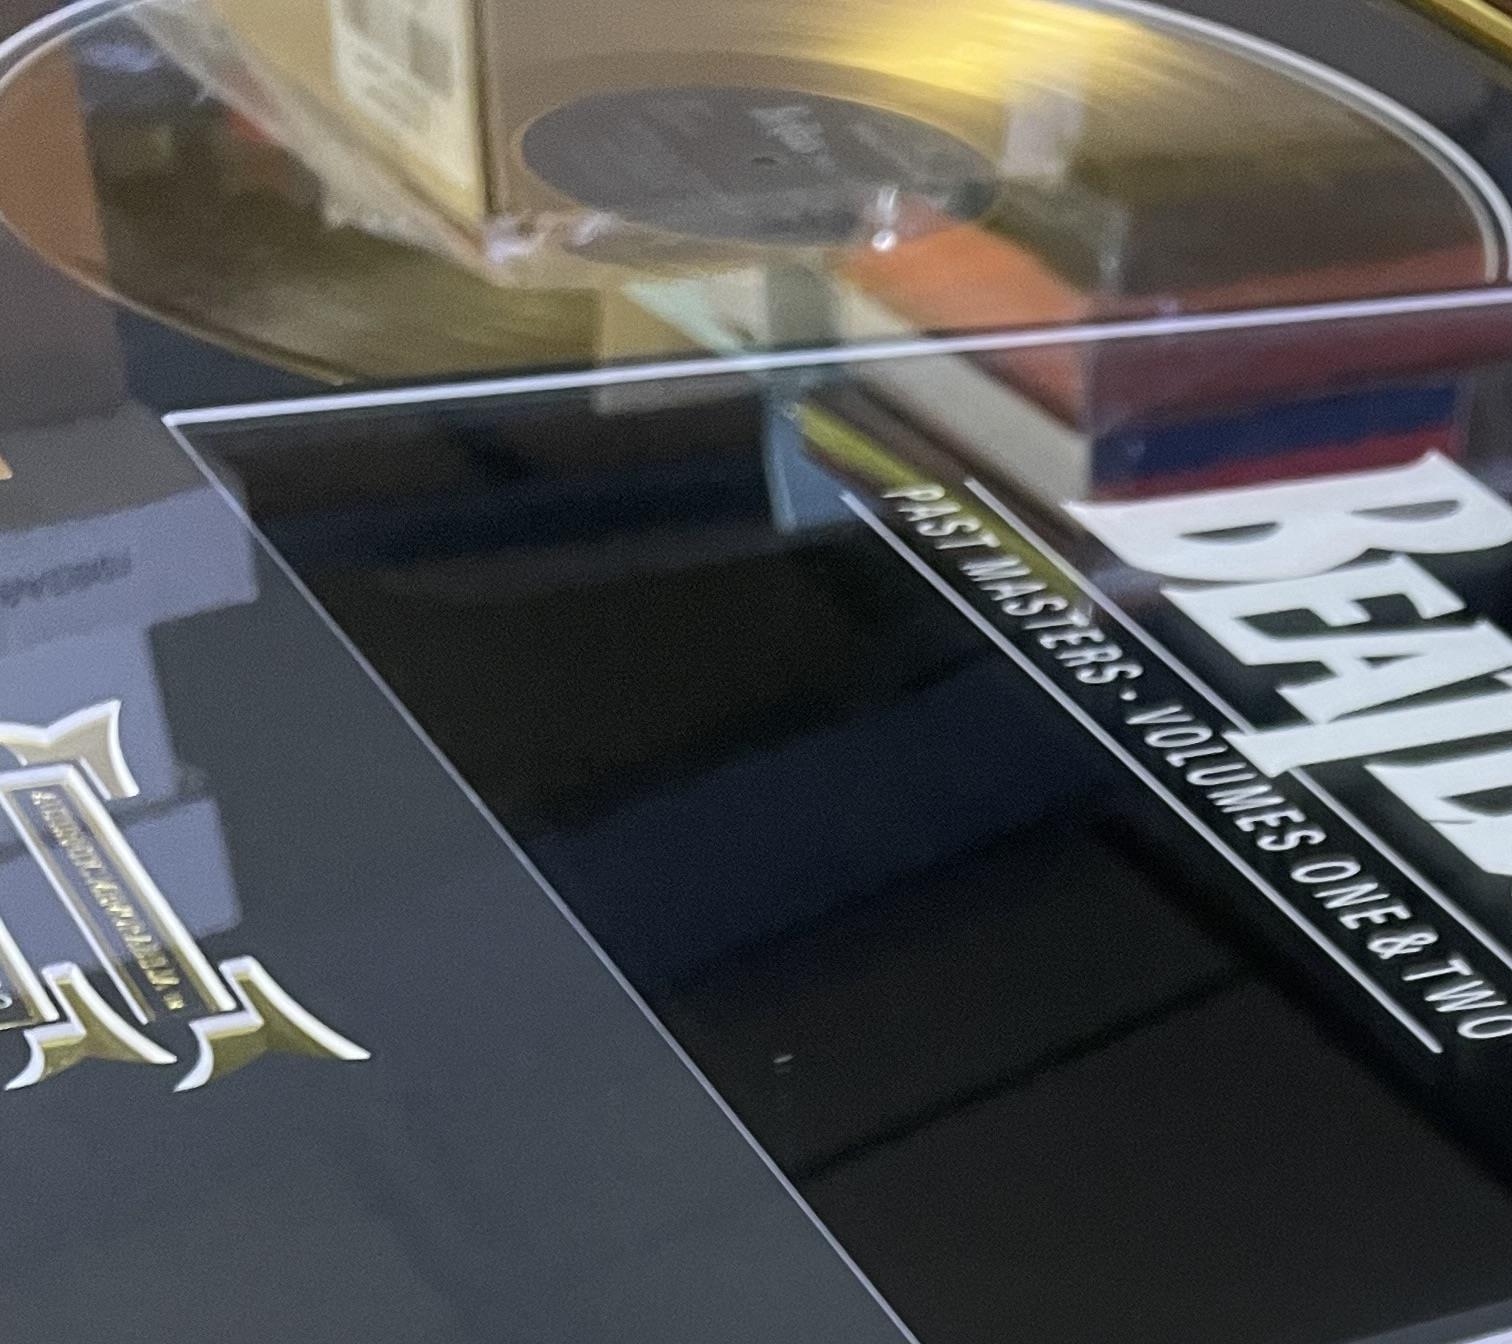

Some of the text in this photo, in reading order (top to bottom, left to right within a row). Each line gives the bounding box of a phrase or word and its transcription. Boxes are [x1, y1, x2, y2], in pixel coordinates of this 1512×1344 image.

[881, 484, 1001, 550] PAST
[958, 555, 1144, 685] MASTERS
[1125, 705, 1327, 852] VOLUMES
[1290, 855, 1412, 930] ONE
[1367, 926, 1440, 960] &
